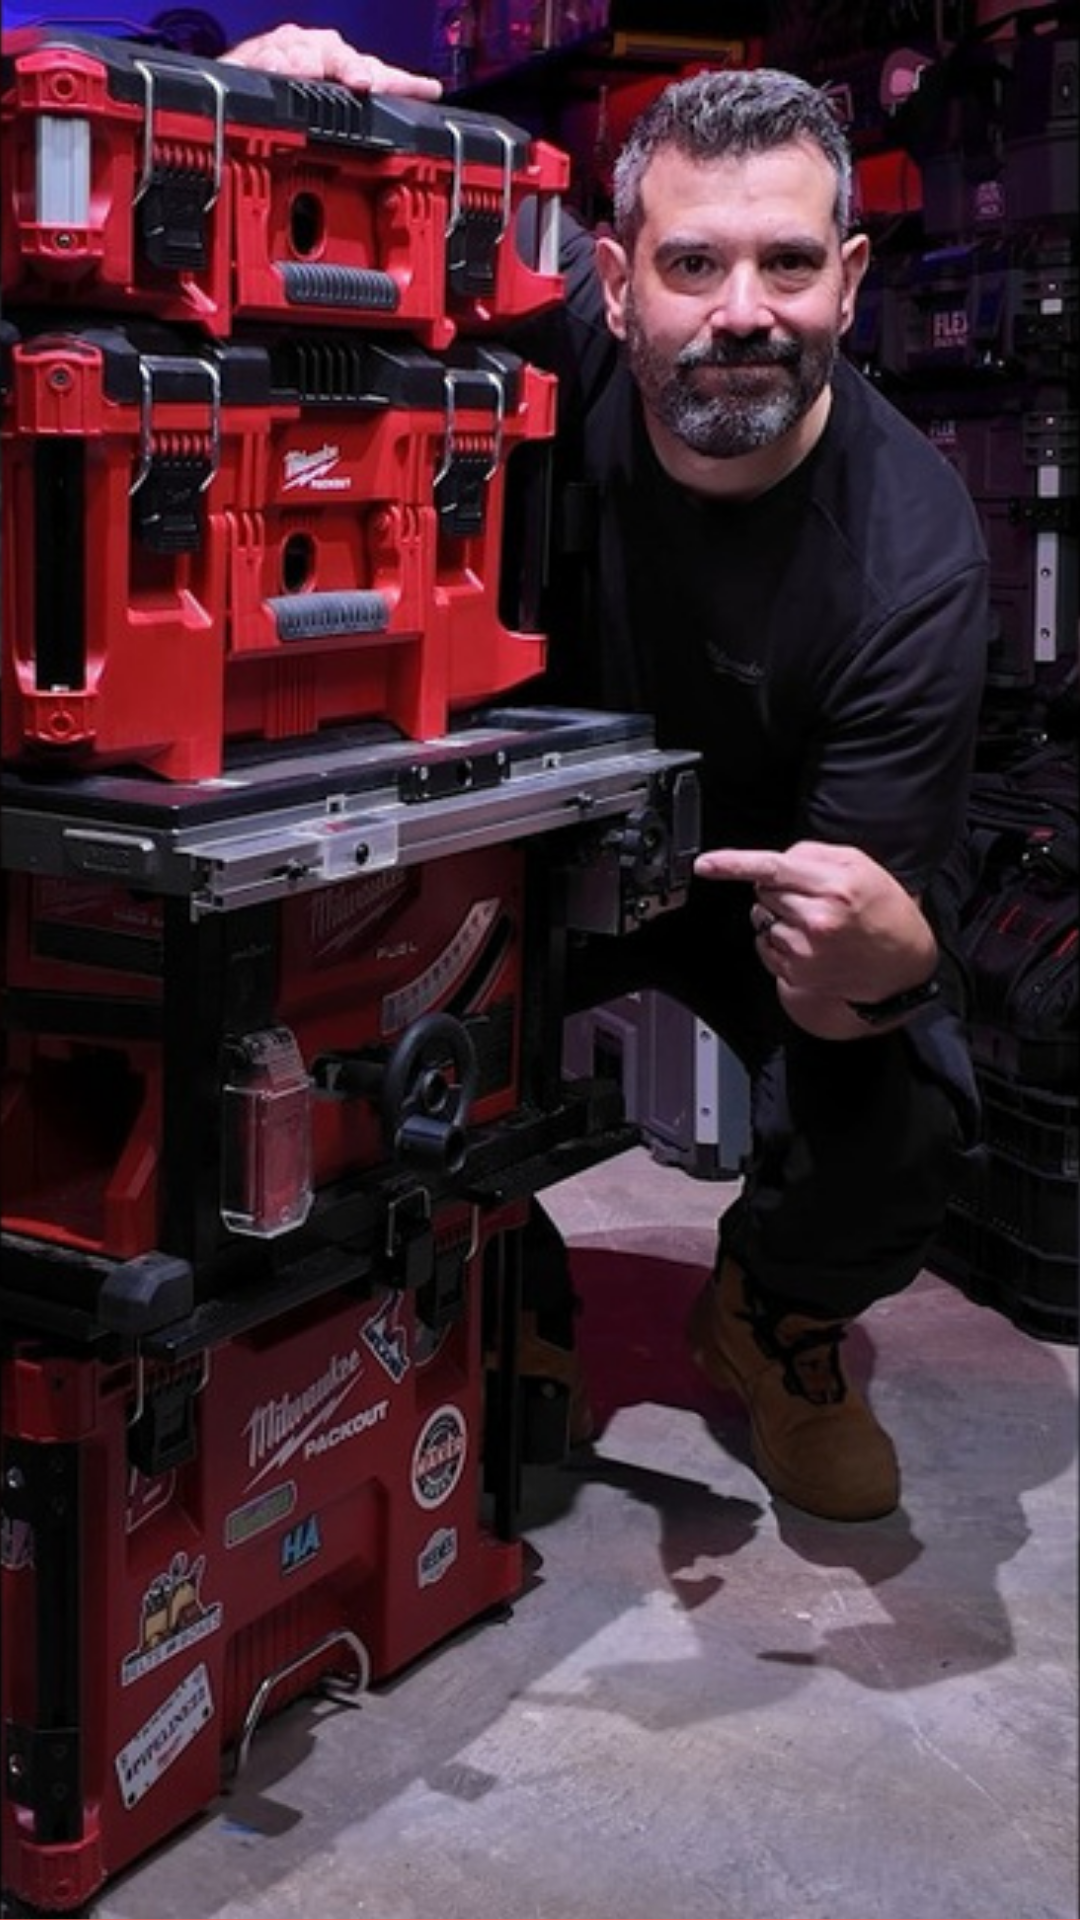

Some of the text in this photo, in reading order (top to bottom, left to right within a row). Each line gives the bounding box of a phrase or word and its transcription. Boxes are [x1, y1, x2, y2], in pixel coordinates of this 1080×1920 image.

[240, 1348, 361, 1469] Milwaukee
[303, 1399, 391, 1461] PACKOUT
[281, 1512, 321, 1567] HA
